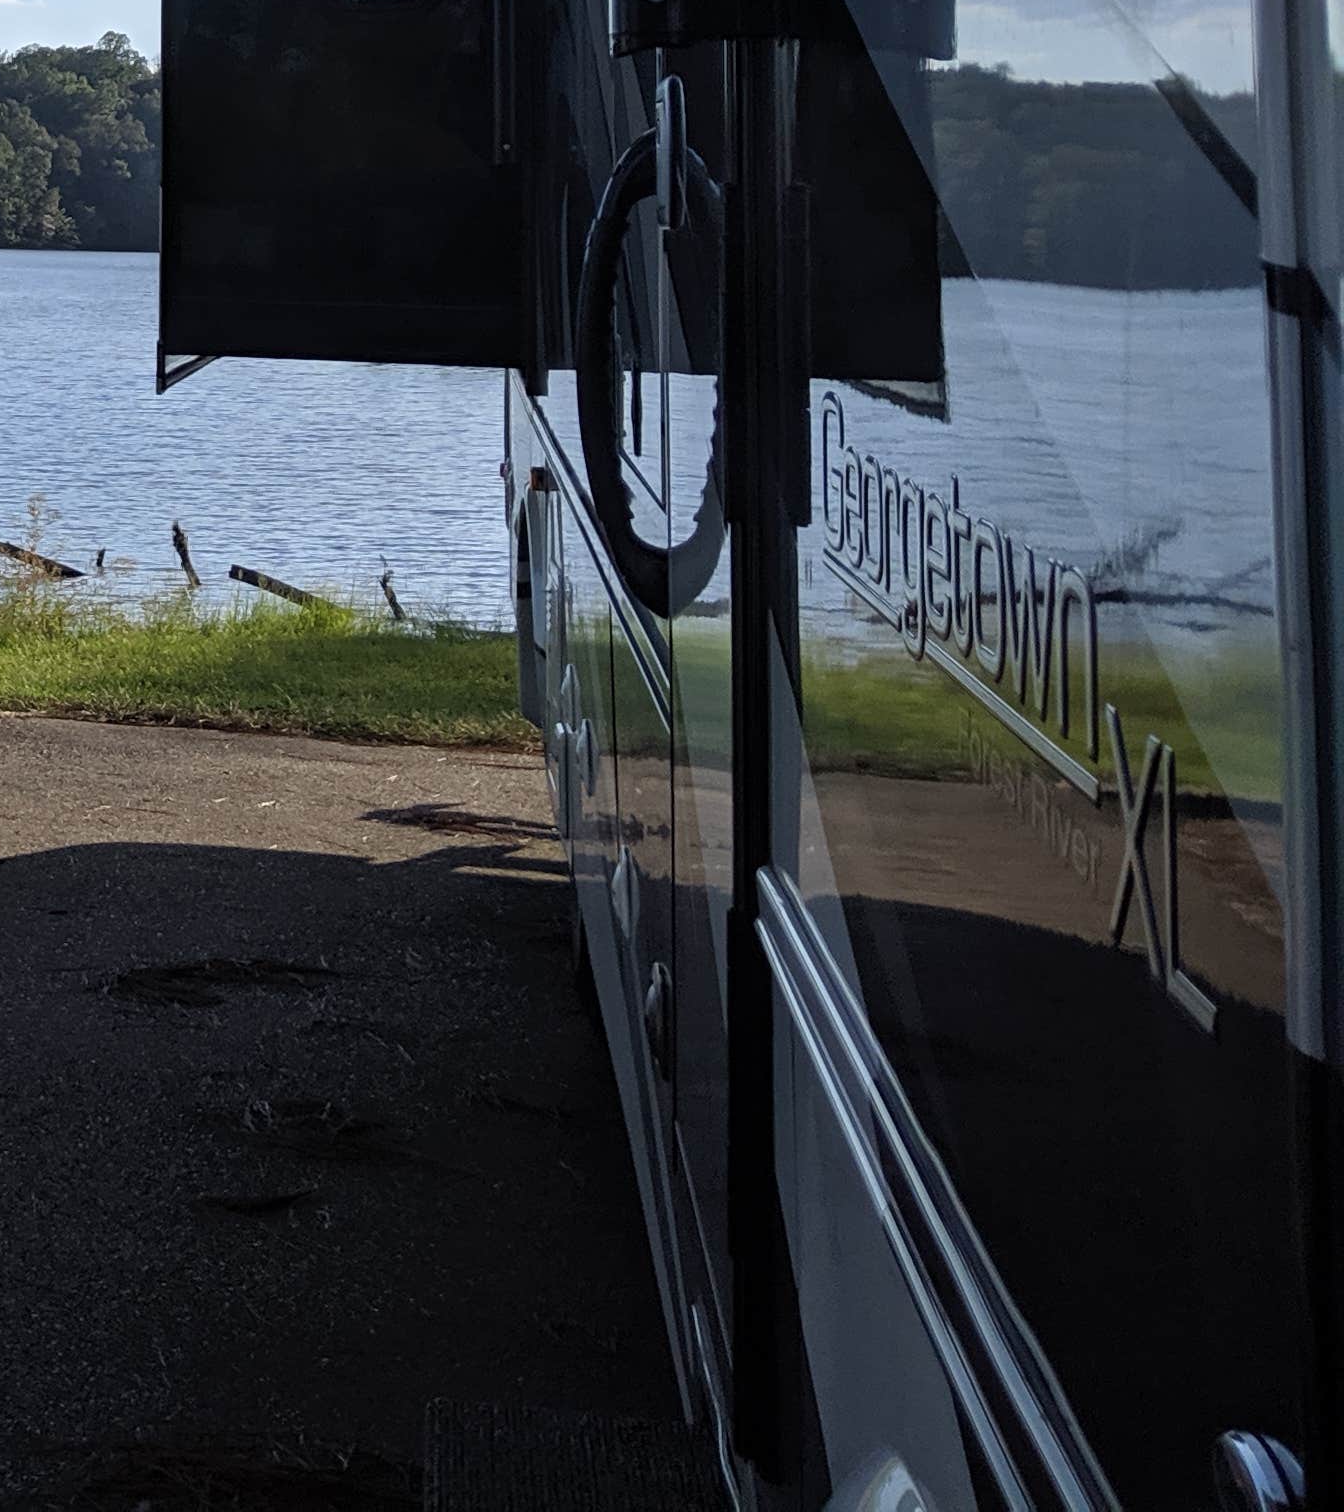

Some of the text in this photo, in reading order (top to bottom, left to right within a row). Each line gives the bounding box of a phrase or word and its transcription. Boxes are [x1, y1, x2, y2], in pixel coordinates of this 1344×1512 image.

[821, 390, 1219, 1037] Georgetown XL
[1031, 771, 1102, 888] River
